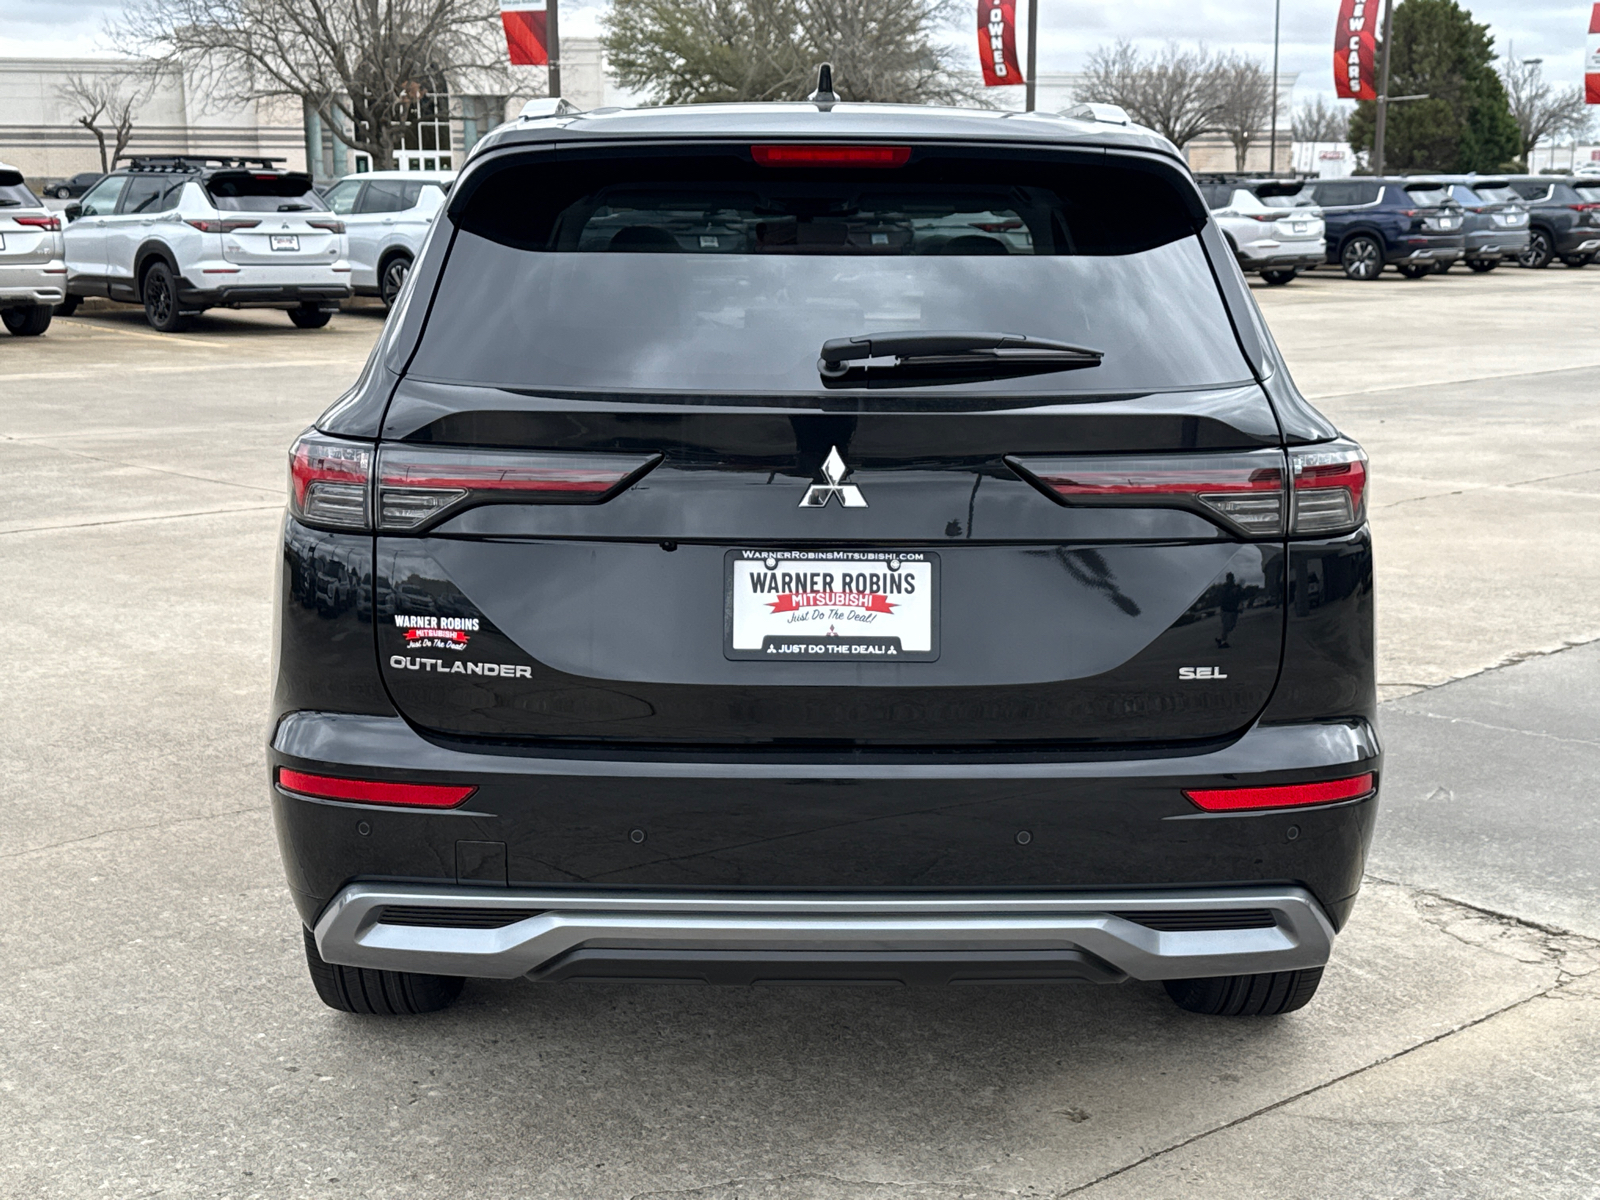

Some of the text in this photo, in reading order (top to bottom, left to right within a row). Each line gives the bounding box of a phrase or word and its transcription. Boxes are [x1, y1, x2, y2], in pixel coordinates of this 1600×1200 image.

[1348, 35, 1361, 92] CARS
[749, 572, 915, 595] WARNER ROBINS
[791, 593, 873, 607] MITSUBISHI
[394, 614, 480, 631] WARNER ROBINS
[787, 608, 877, 624] Just Do The Deal!
[778, 644, 885, 654] JUST DO THE DEAL!
[389, 655, 533, 679] OUTLANDER
[1178, 666, 1228, 680] SEL
